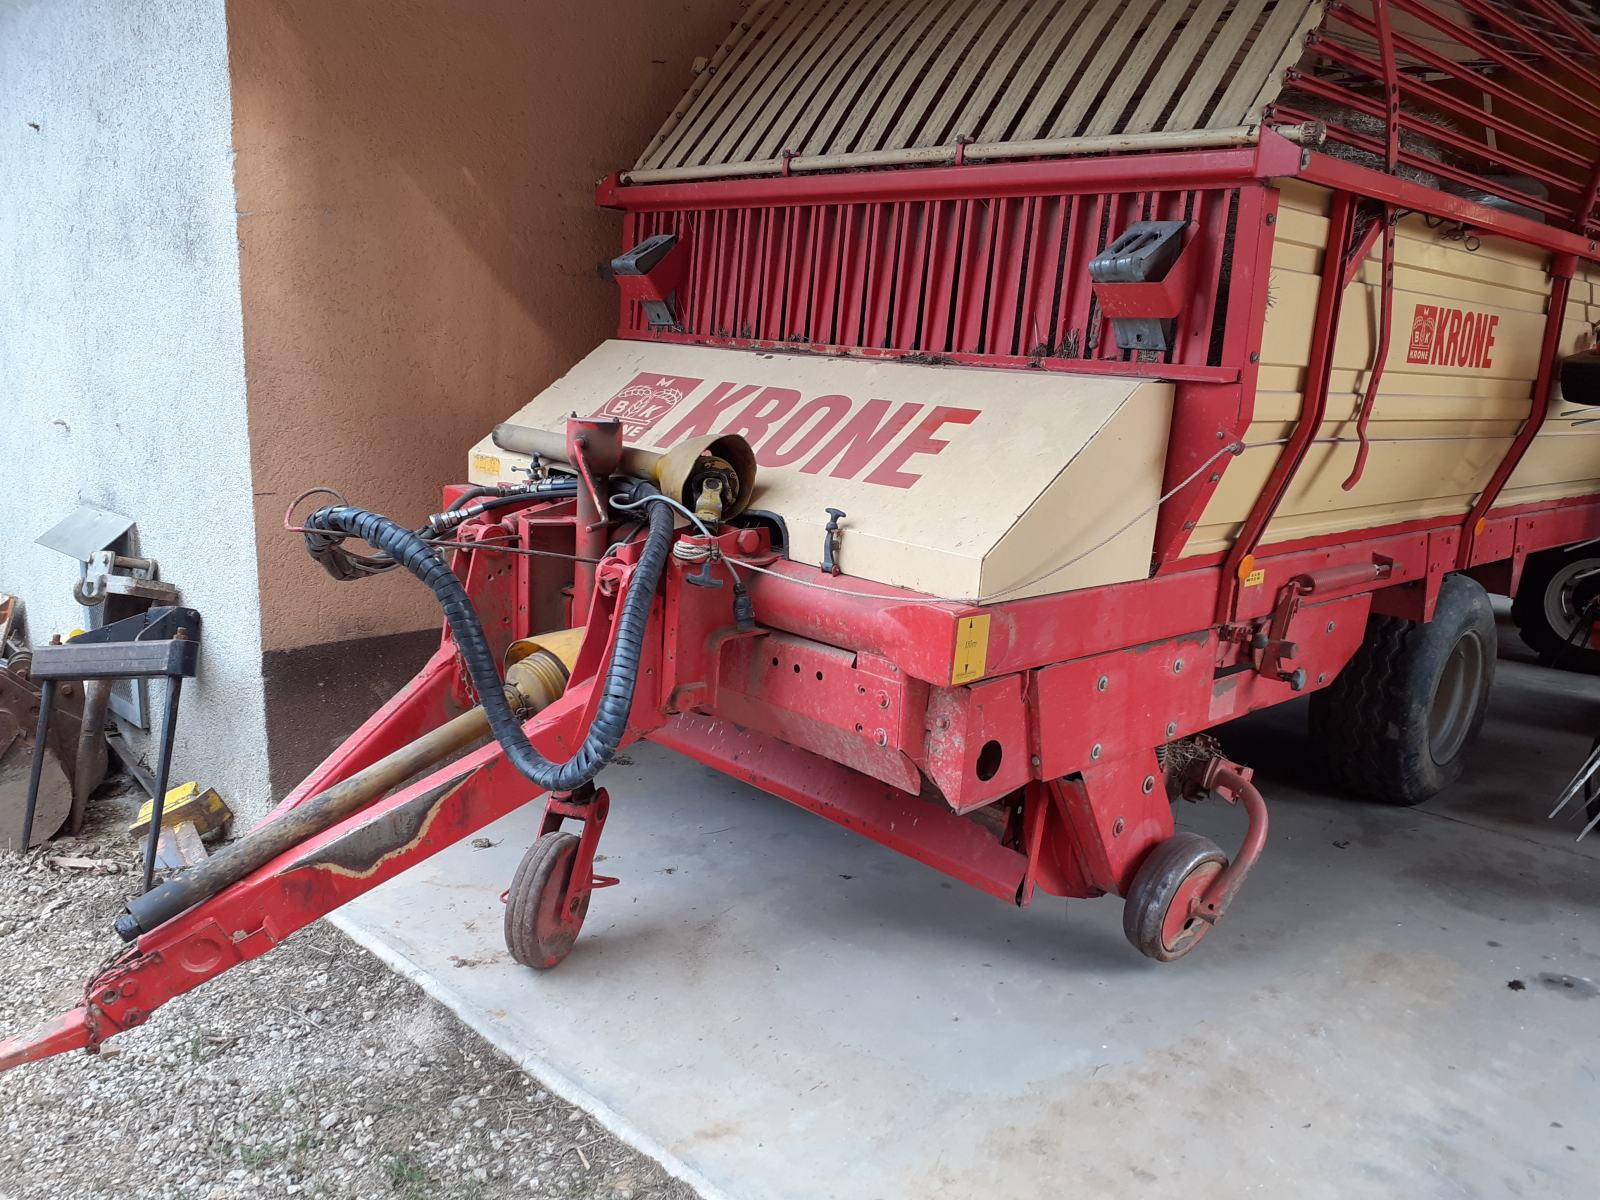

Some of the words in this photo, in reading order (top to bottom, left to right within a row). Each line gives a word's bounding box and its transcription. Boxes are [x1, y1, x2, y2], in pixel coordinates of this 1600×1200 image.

[1414, 331, 1420, 343] B
[1425, 333, 1431, 344] K
[1431, 308, 1499, 368] KRONE
[1409, 350, 1429, 360] KRONE
[655, 377, 677, 387] M
[611, 400, 630, 414] B
[638, 404, 664, 418] K
[653, 381, 983, 490] KRONE
